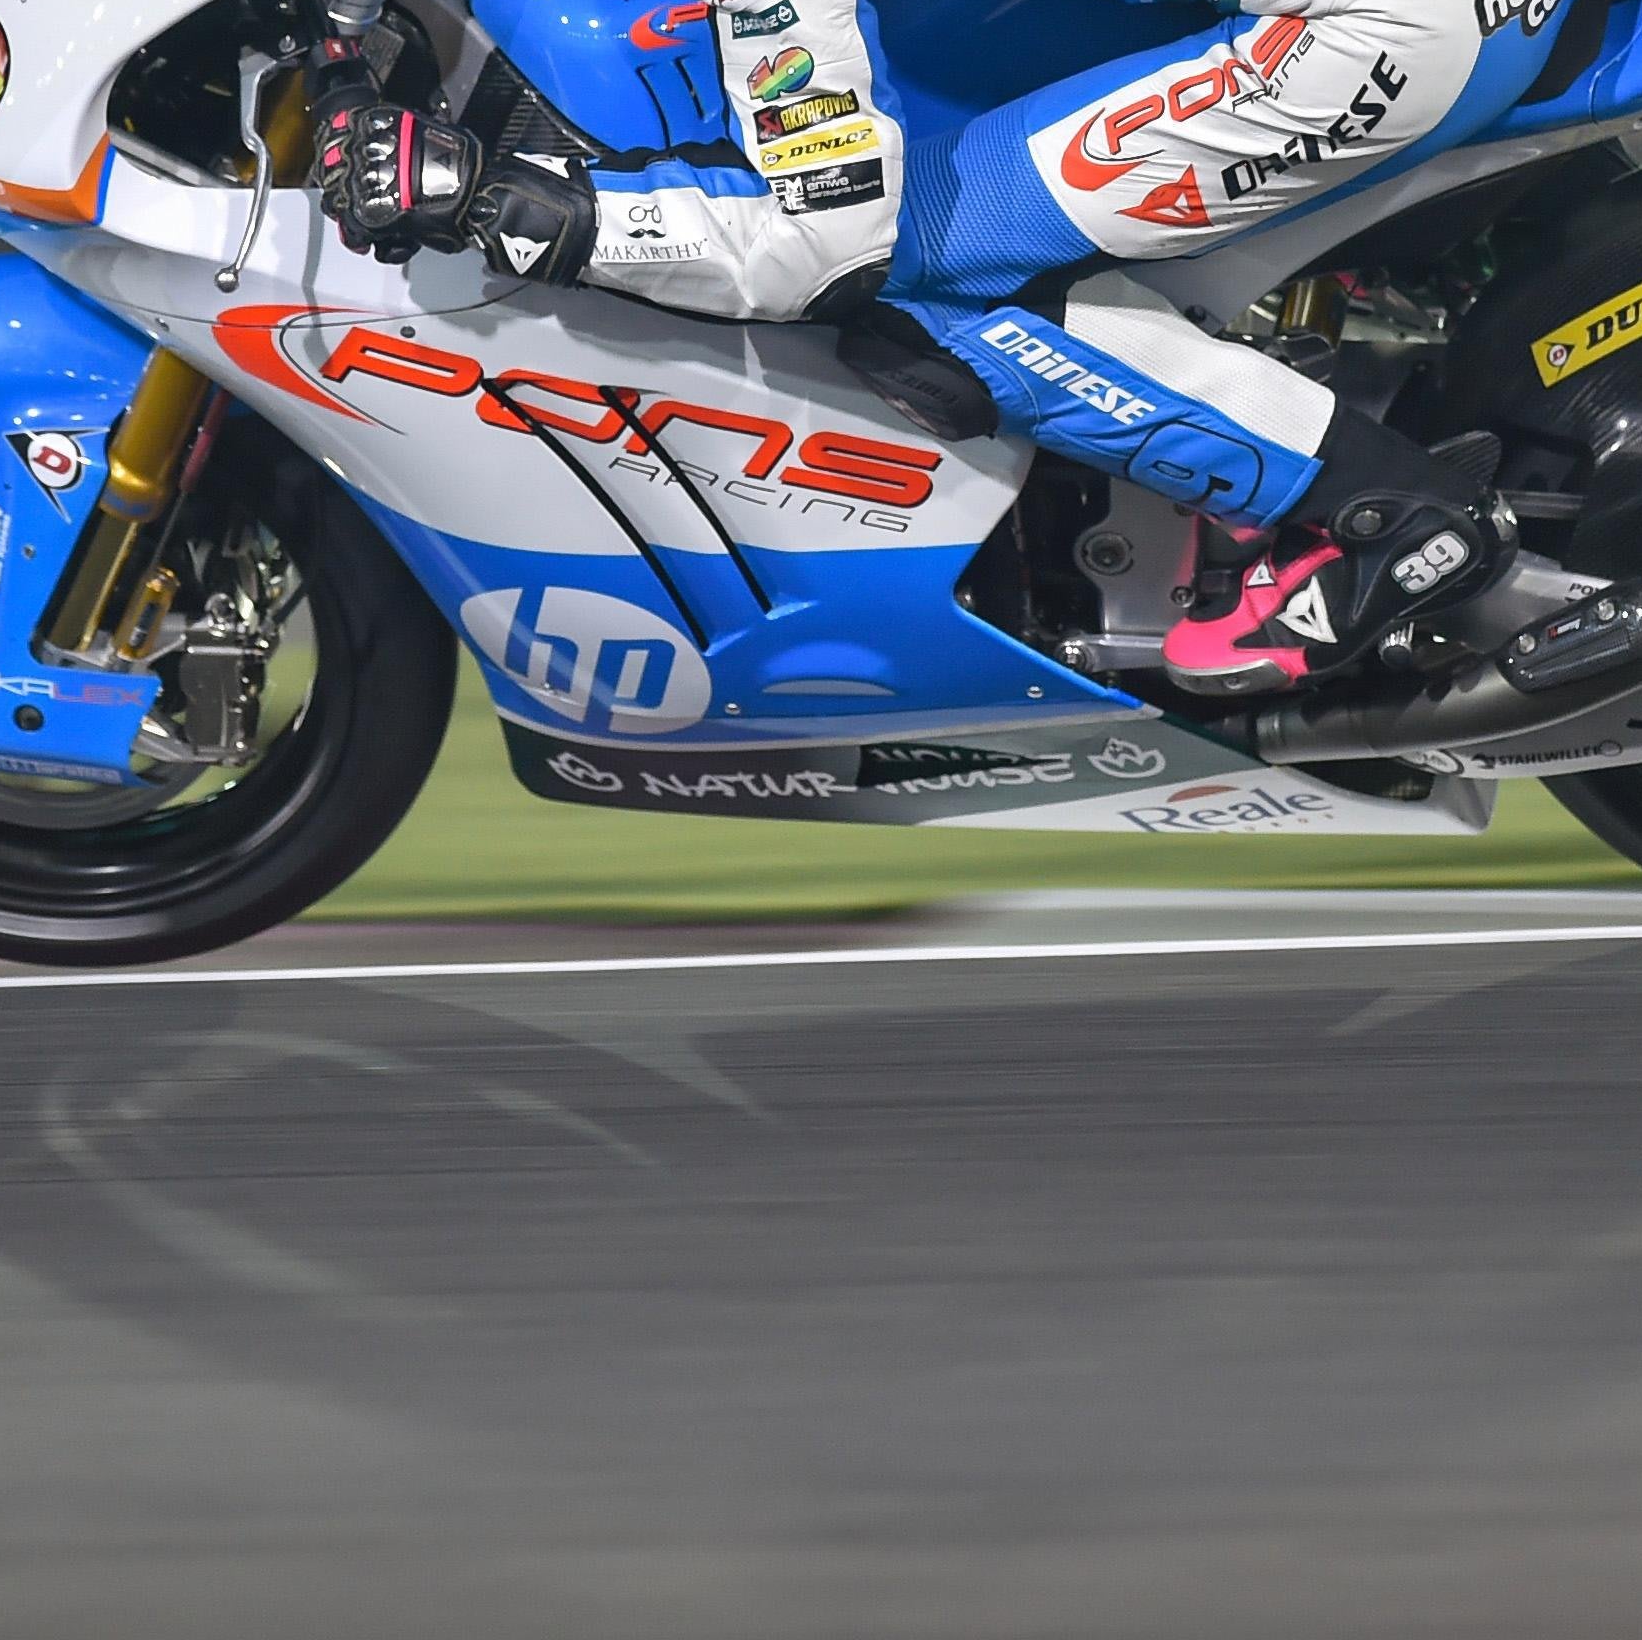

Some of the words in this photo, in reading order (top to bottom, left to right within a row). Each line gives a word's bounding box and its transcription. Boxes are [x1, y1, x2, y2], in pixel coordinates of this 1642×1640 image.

[789, 127, 873, 159] DUNLOP
[594, 240, 703, 260] MAKARTHY
[979, 320, 1157, 426] DAINESE
[1391, 530, 1470, 594] 39
[503, 585, 678, 734] hp
[639, 770, 857, 799] NATUR
[1119, 787, 1334, 833] Reale
